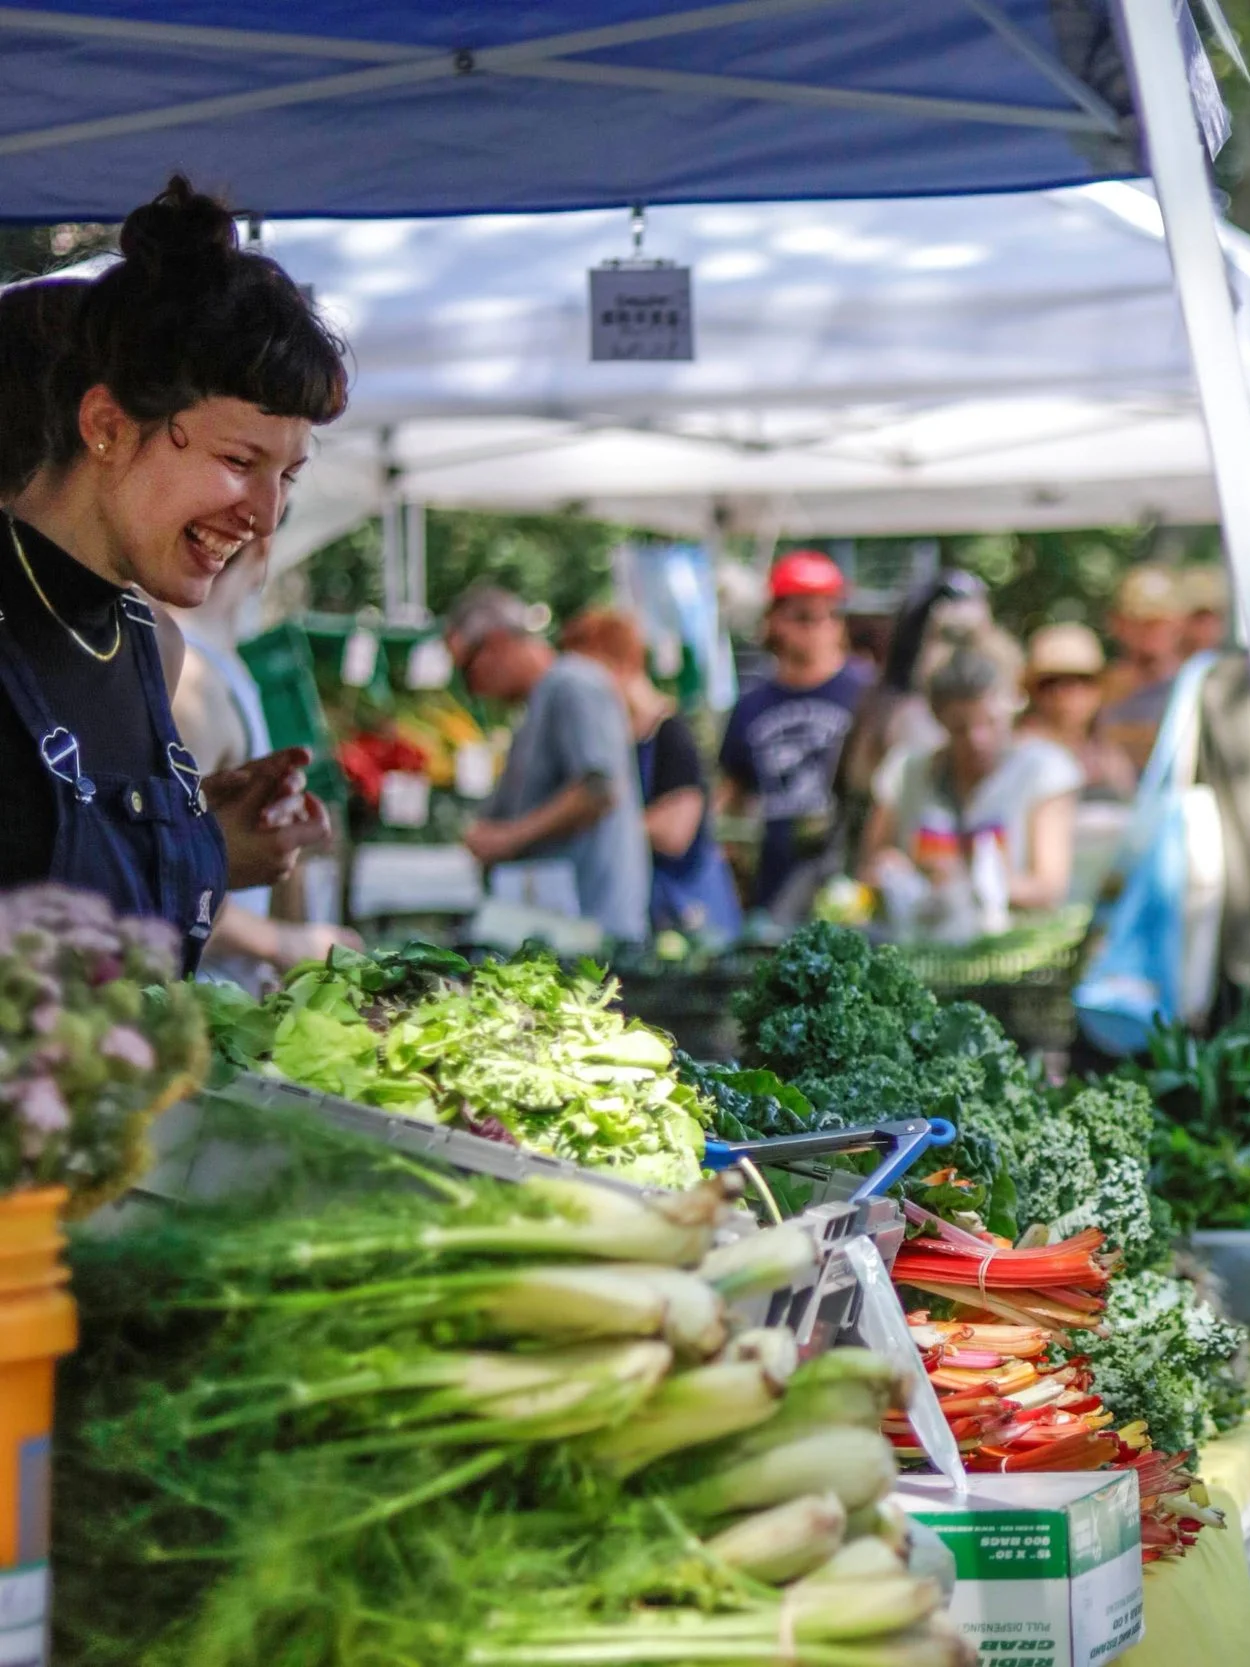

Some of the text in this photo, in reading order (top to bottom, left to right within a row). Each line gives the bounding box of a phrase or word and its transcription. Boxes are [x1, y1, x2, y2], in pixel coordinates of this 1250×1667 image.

[980, 1536, 1021, 1547] BAGS
[962, 1622, 1052, 1634] PULL DISPENSING
[979, 1640, 1056, 1651] GRAB
[989, 1657, 1055, 1667] REDI
